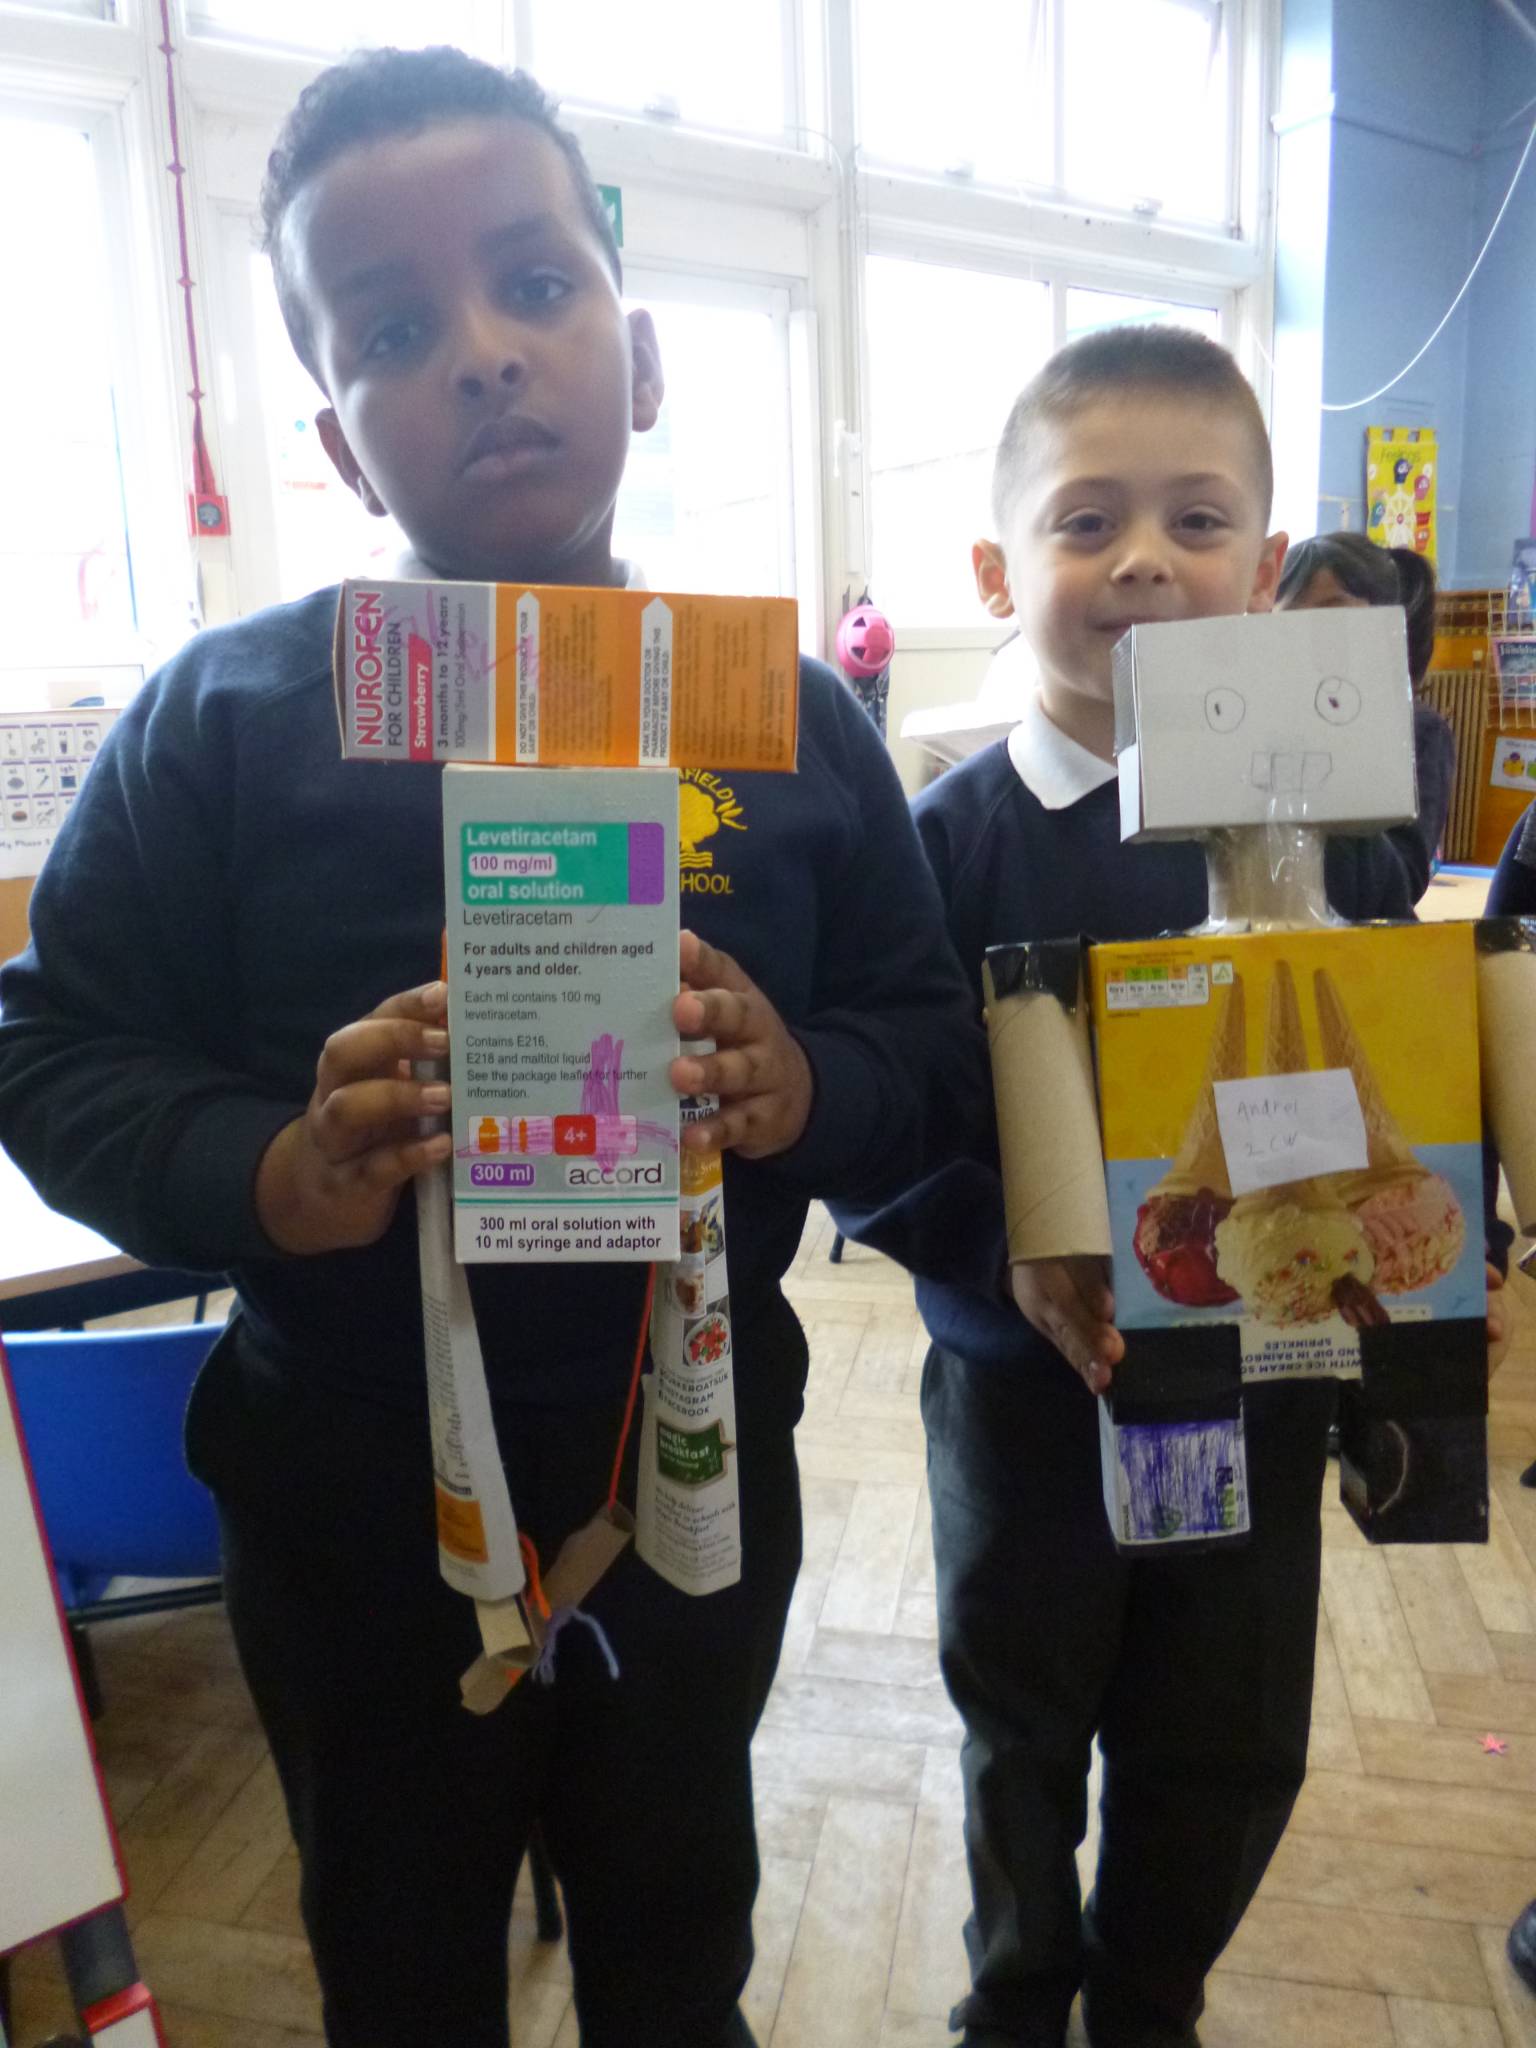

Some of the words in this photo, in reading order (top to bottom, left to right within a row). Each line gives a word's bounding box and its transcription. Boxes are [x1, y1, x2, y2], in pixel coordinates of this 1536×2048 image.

[439, 596, 451, 636] years
[455, 603, 467, 659] Suspension
[437, 640, 449, 657] 12
[354, 591, 384, 747] NUROFEN
[387, 621, 402, 706] CHILDREN
[439, 663, 449, 679] to
[454, 662, 466, 687] Oral
[519, 684, 528, 699] THIS
[414, 662, 429, 748] Strawberry
[438, 683, 449, 736] months
[519, 702, 528, 721] GIVE
[387, 712, 402, 746] FOR
[519, 723, 527, 739] NOT
[438, 739, 449, 748] 3
[466, 827, 597, 846] Levetiracetam
[470, 856, 499, 871] 100
[503, 855, 552, 874] mg/ml
[467, 880, 503, 899] oral
[509, 880, 584, 899] solution
[680, 872, 734, 894] HOOL
[463, 909, 573, 926] Levetiracetam
[464, 943, 486, 955] For
[490, 942, 531, 956] adults
[535, 942, 560, 955] and
[563, 941, 617, 955] children
[621, 942, 653, 958] aged
[464, 963, 472, 976] 4
[476, 965, 511, 979] years
[516, 963, 541, 976] and
[544, 963, 582, 976] older.
[465, 991, 492, 1003] Each
[496, 991, 509, 1002] ml
[512, 991, 557, 1003] contains
[561, 991, 583, 1003] 100
[586, 993, 601, 1006] mg
[465, 1009, 540, 1021] levetiracetam.
[466, 1035, 513, 1048] Contains
[466, 1053, 495, 1064] E218
[498, 1053, 518, 1064] and
[521, 1053, 560, 1064] maltitol
[467, 1070, 488, 1082] See
[491, 1070, 508, 1081] the
[511, 1070, 557, 1085] package
[560, 1070, 593, 1082] leaflet
[595, 1070, 611, 1081] for
[613, 1069, 648, 1081] further
[467, 1087, 529, 1098] information.
[564, 1126, 588, 1144] 4+
[474, 1164, 504, 1182] 300
[509, 1164, 531, 1181] ml
[569, 1162, 663, 1186] accord
[480, 1217, 505, 1230] 300
[509, 1217, 527, 1230] ml
[531, 1216, 558, 1230] oral
[562, 1216, 619, 1230] solution
[625, 1216, 656, 1230] with
[475, 1236, 492, 1249] 10
[496, 1236, 513, 1249] ml
[517, 1235, 571, 1252] syringe
[575, 1235, 602, 1249] and
[606, 1235, 662, 1252] adaptor
[1264, 1337, 1332, 1350] SPRINKLES
[1241, 1351, 1293, 1363] RAINBO
[1296, 1350, 1309, 1359] IN
[1313, 1348, 1333, 1358] DIP
[1260, 1362, 1302, 1374] CREAM
[1306, 1361, 1326, 1371] ICE
[1330, 1359, 1361, 1369] WITH
[660, 1440, 710, 1461] breakfast
